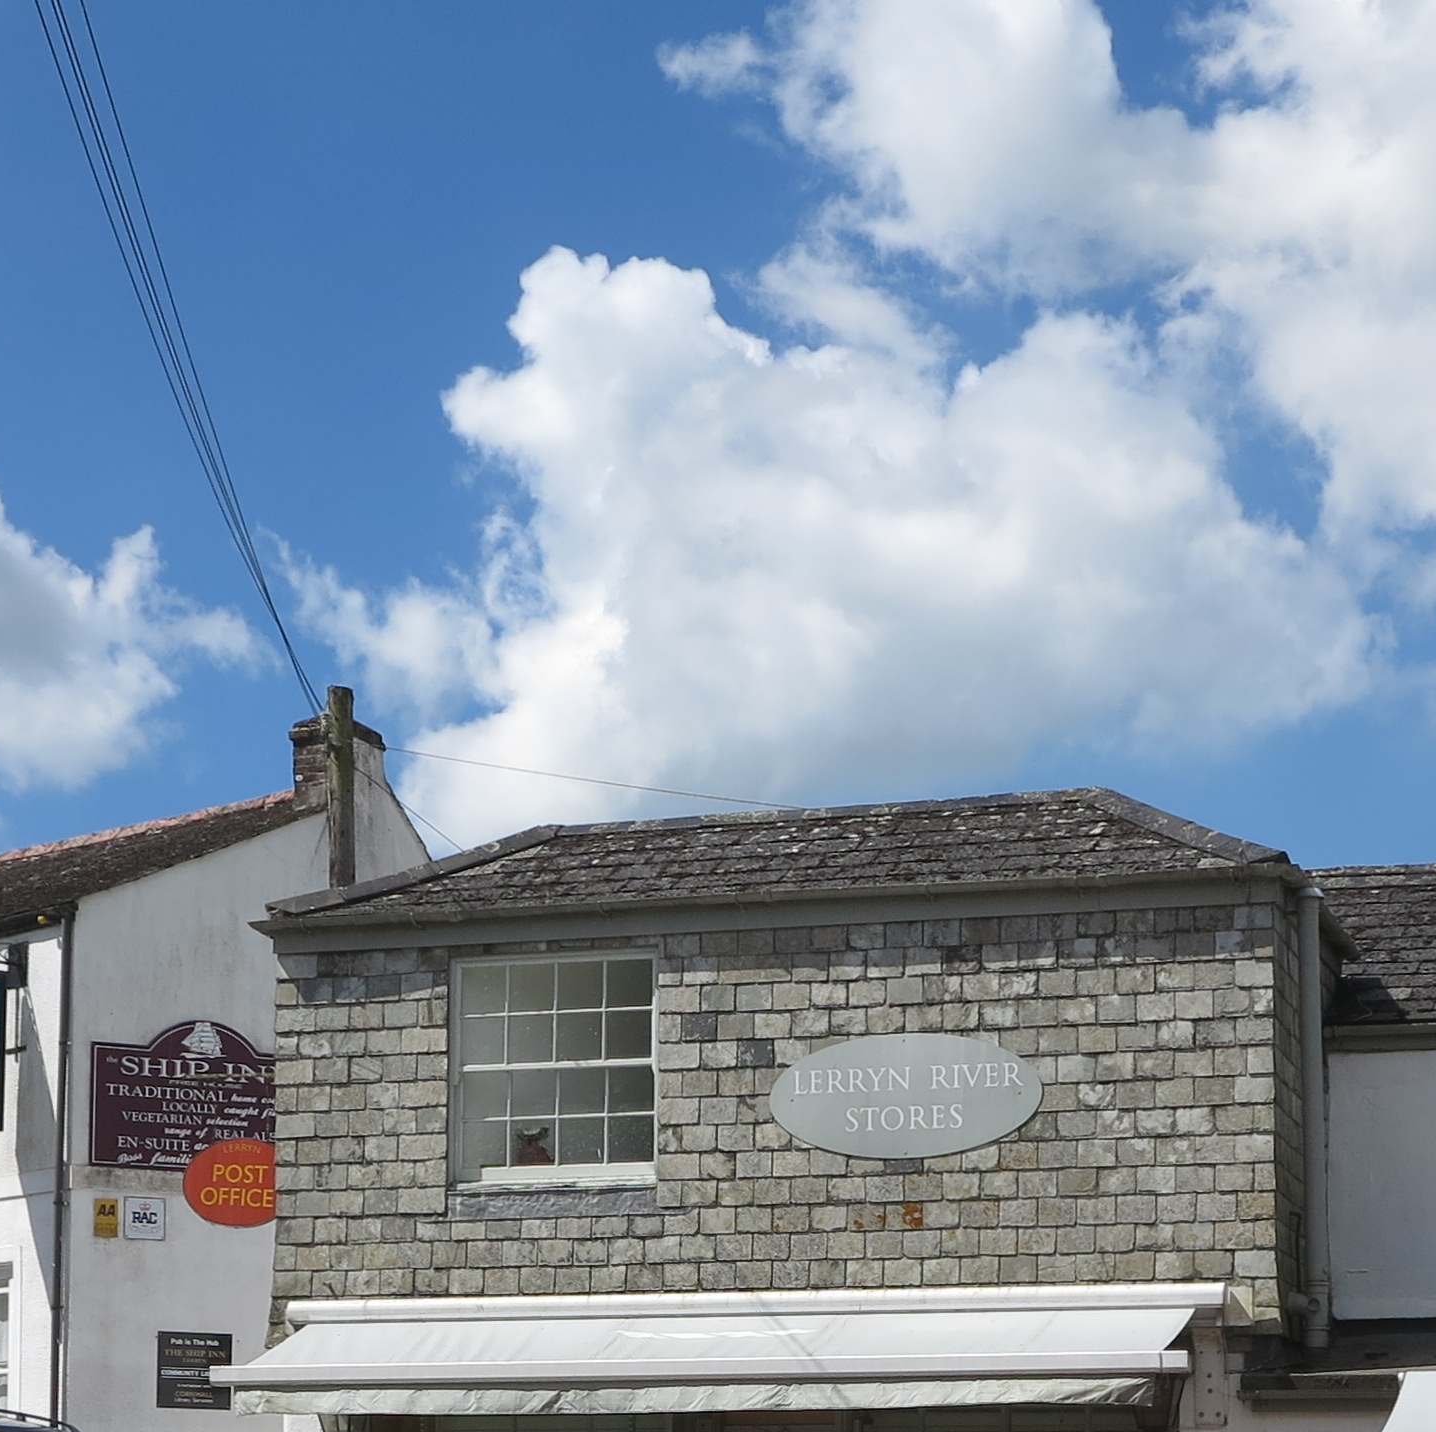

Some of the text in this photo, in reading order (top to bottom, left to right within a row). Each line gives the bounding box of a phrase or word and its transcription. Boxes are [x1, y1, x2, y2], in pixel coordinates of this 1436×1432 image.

[120, 1055, 210, 1079] SHIP
[793, 1062, 1024, 1096] LERRYN RIVER
[106, 1083, 228, 1103] TRADITIONAL
[162, 1101, 217, 1115] LOCALLY
[122, 1111, 249, 1127] VEGETARIAN selection
[845, 1104, 964, 1132] STORES
[117, 1135, 190, 1152] EN-SUITE
[222, 1143, 262, 1154] LERRYN
[150, 1151, 192, 1165] famili
[212, 1163, 269, 1184] POST
[200, 1186, 274, 1208] OFFICE
[97, 1204, 116, 1217] AA
[131, 1211, 158, 1224] RAC
[208, 1350, 226, 1358] INN
